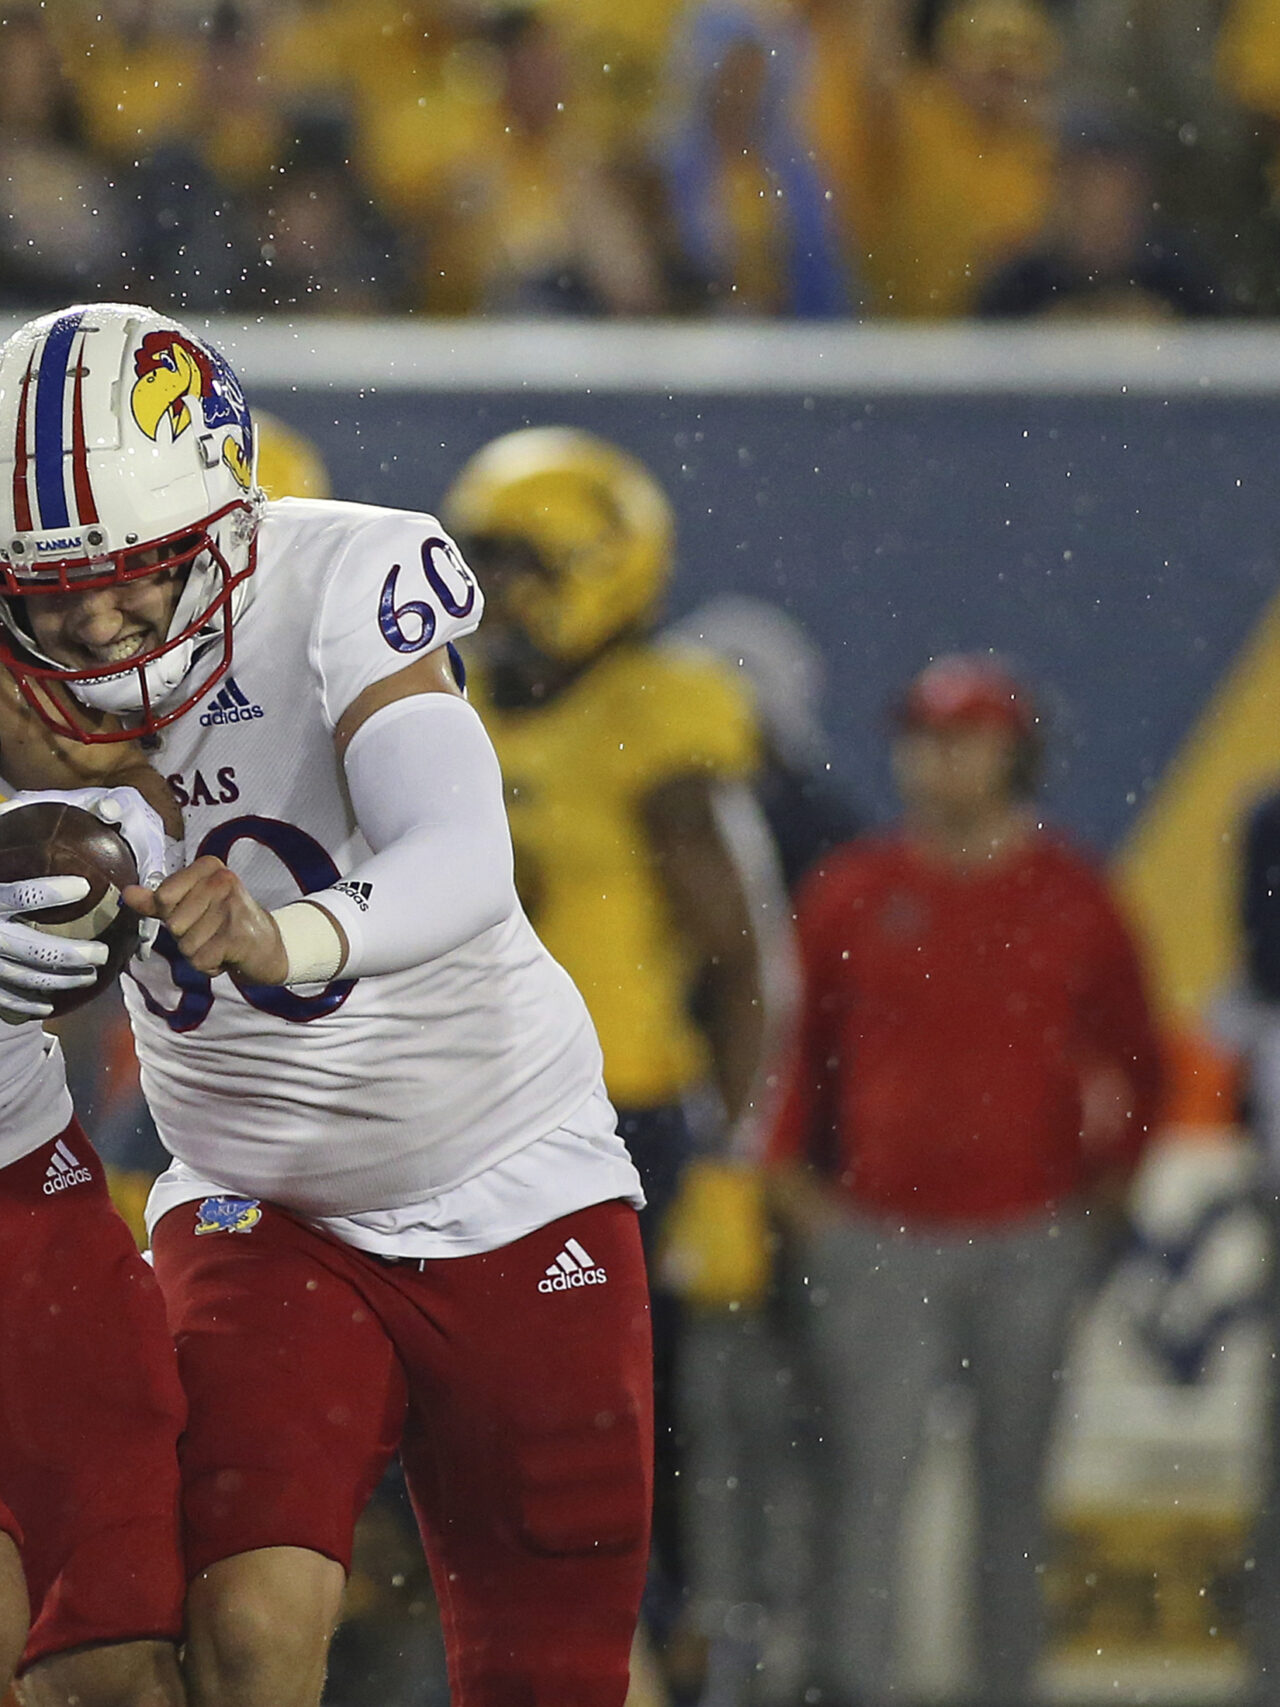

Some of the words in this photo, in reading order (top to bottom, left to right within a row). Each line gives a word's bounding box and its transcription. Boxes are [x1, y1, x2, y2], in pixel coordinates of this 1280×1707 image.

[35, 536, 82, 551] KANSAS
[378, 537, 475, 653] 60
[200, 704, 264, 727] adidas
[166, 766, 240, 808] SAS
[42, 1167, 92, 1195] adidas
[537, 1267, 608, 1294] adidas
